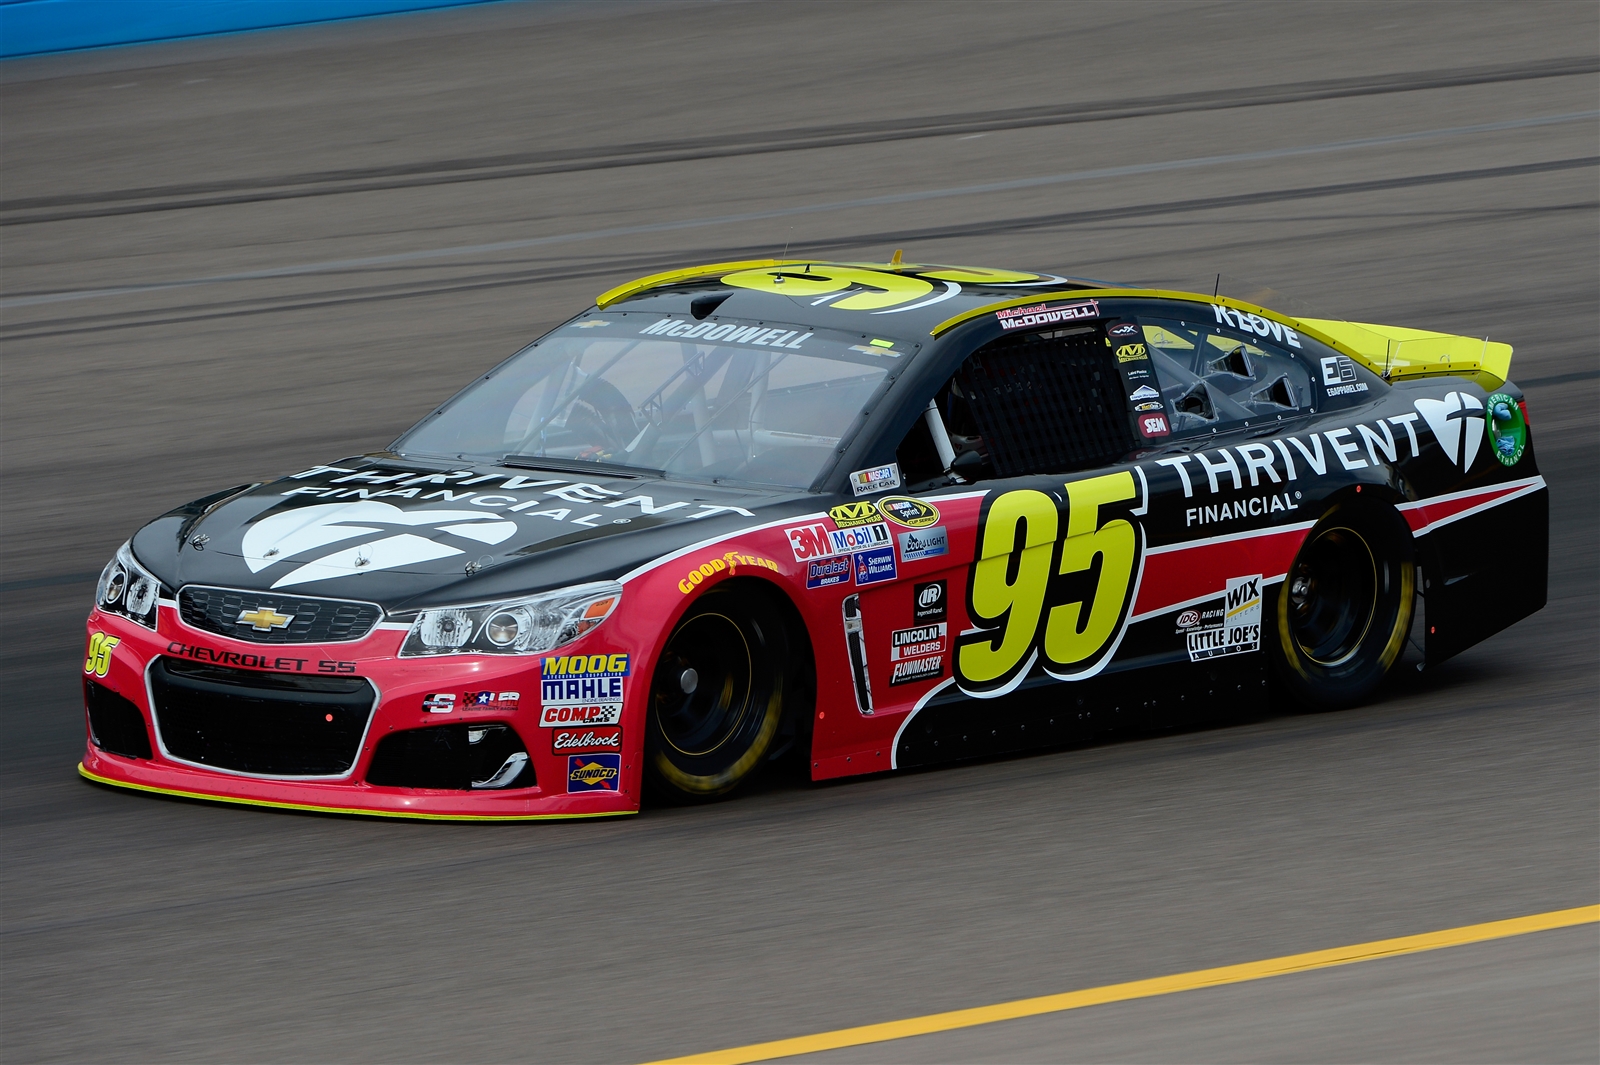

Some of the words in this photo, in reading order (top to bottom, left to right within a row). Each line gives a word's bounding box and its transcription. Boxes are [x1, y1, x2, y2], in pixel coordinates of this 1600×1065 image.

[995, 303, 1047, 319] Michael
[1000, 307, 1096, 330] McDOWELL
[638, 318, 814, 350] McDOWELL
[1487, 393, 1519, 416] AMERICAN
[1144, 417, 1167, 434] SEM
[1154, 412, 1420, 498] THRIVENT
[1496, 444, 1525, 466] ETHANOL
[867, 468, 892, 482] NASCAR
[290, 465, 756, 519] THRIVENT
[856, 483, 878, 493] RACE
[879, 480, 896, 488] CAR
[900, 507, 920, 518] Sprint
[790, 525, 833, 559] 3M
[833, 526, 872, 549] Mobil
[873, 524, 887, 542] 1
[926, 536, 945, 548] LIGHT
[810, 558, 849, 578] Duralast
[868, 555, 892, 566] SHERWIN
[820, 576, 840, 585] BRAKES
[957, 470, 1138, 684] 95
[922, 588, 938, 604] IR
[1227, 577, 1260, 610] WIX
[1202, 609, 1225, 619] RACING
[1226, 604, 1260, 624] FILTERS
[894, 627, 937, 646] LINCOLN
[1188, 630, 1225, 651] LITTLE
[1228, 624, 1260, 645] JOE'S
[84, 631, 121, 678] 95
[166, 641, 309, 672] CHEVROLET
[317, 660, 357, 673] SS
[903, 641, 941, 656] WELDERS
[1194, 642, 1256, 660] AUTOS
[543, 653, 628, 676] MOOG
[892, 655, 942, 684] FLOWMASTER
[543, 678, 621, 700] MAHLE
[489, 691, 520, 707] LFR
[544, 706, 601, 723] COMP
[582, 716, 611, 724] CAMS
[554, 731, 619, 749] Edelbrock
[571, 768, 616, 780] SUNOCO
